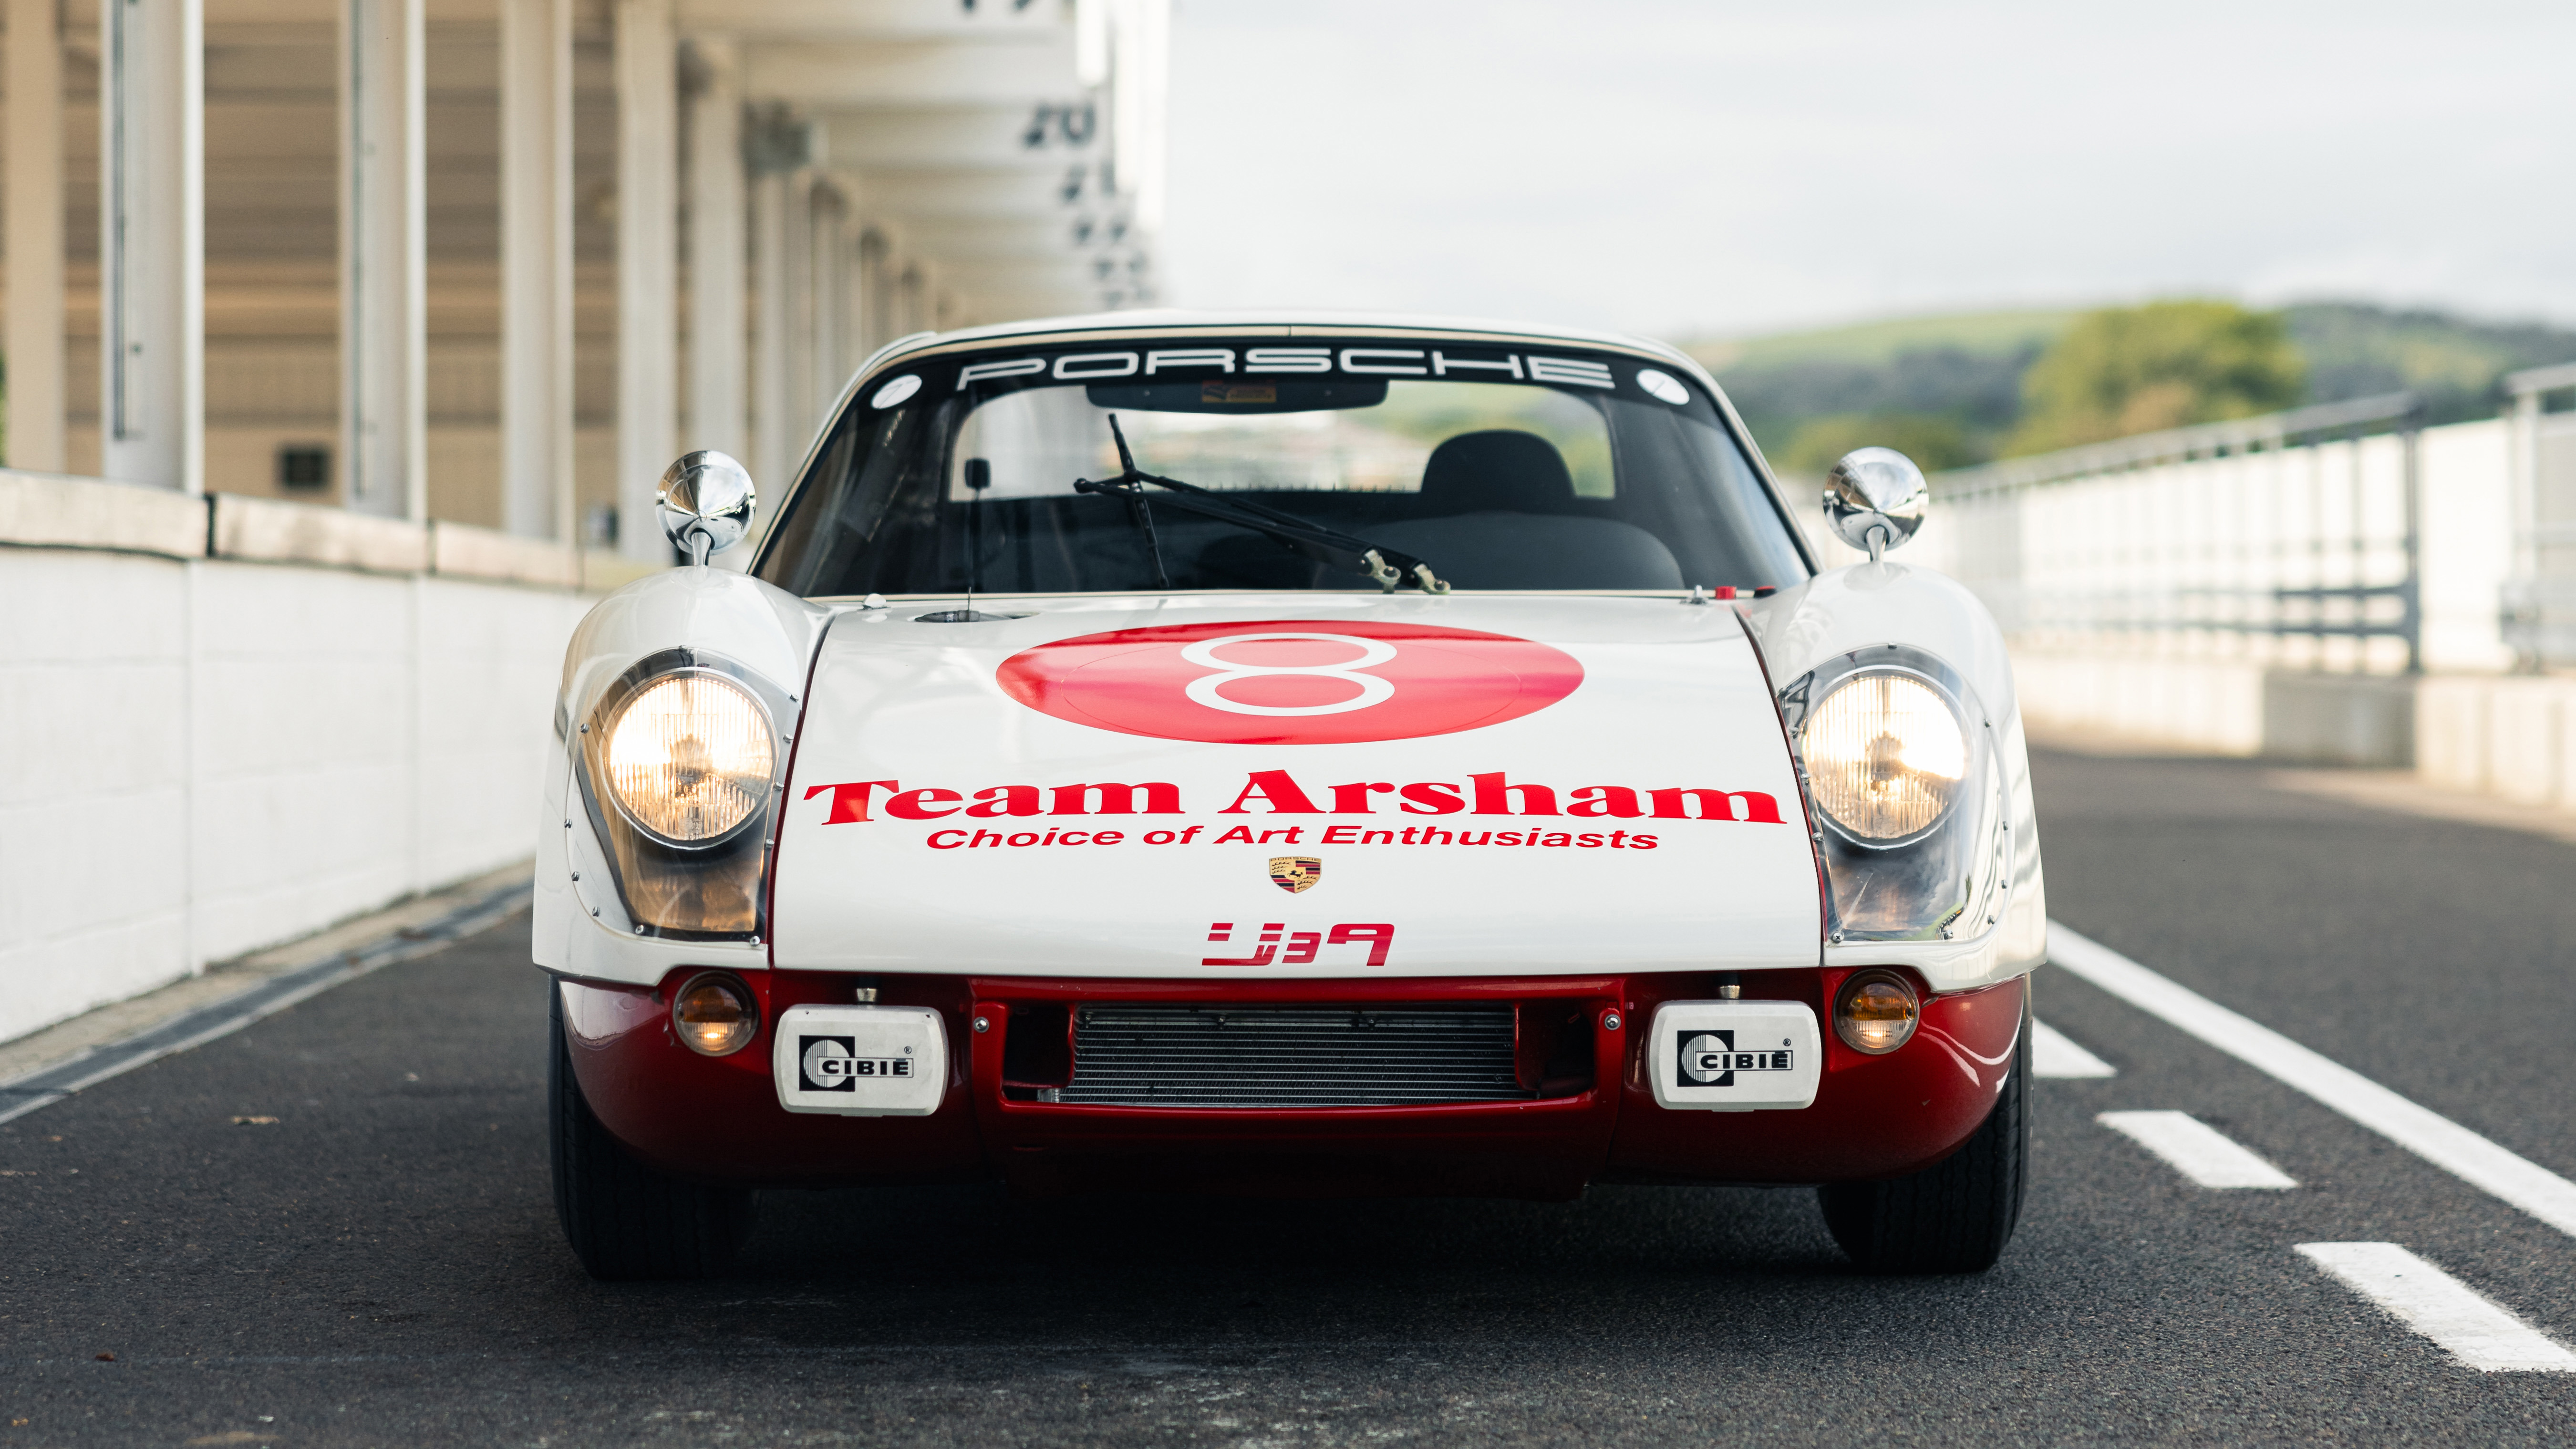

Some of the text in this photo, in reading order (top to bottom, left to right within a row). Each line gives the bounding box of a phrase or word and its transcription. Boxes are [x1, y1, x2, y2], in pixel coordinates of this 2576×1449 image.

[957, 348, 1616, 391] PORSCHE
[1180, 633, 1397, 716] 8
[803, 769, 1788, 826] Team Arsham
[927, 825, 1659, 850] Choice of Art Enthusiasts
